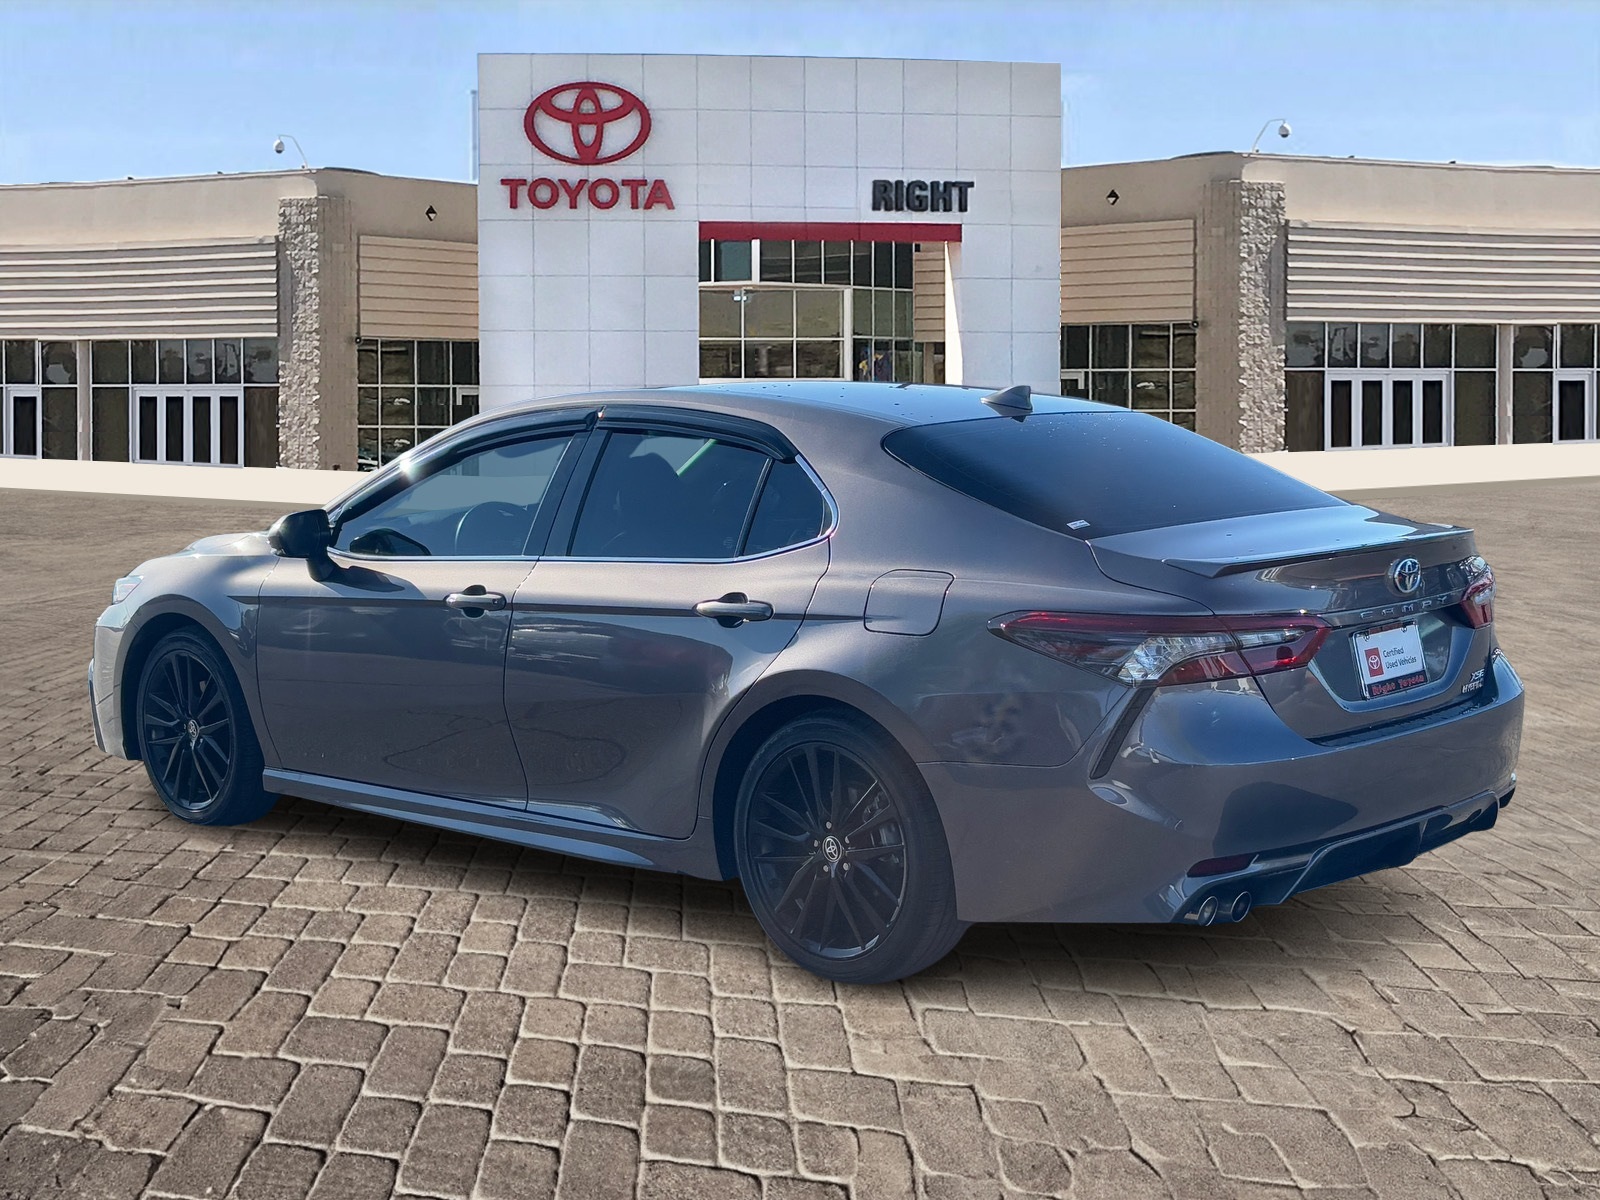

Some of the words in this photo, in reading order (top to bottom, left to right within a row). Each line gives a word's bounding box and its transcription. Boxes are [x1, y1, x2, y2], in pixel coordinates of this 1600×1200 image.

[500, 177, 675, 209] TOYOTA
[872, 179, 975, 212] RIGHT
[1383, 646, 1405, 658] Certified
[1385, 660, 1399, 669] Used
[1398, 655, 1417, 666] Vehicles
[1470, 668, 1485, 682] XSE
[1371, 683, 1396, 695] Right
[1398, 674, 1425, 689] Toyota
